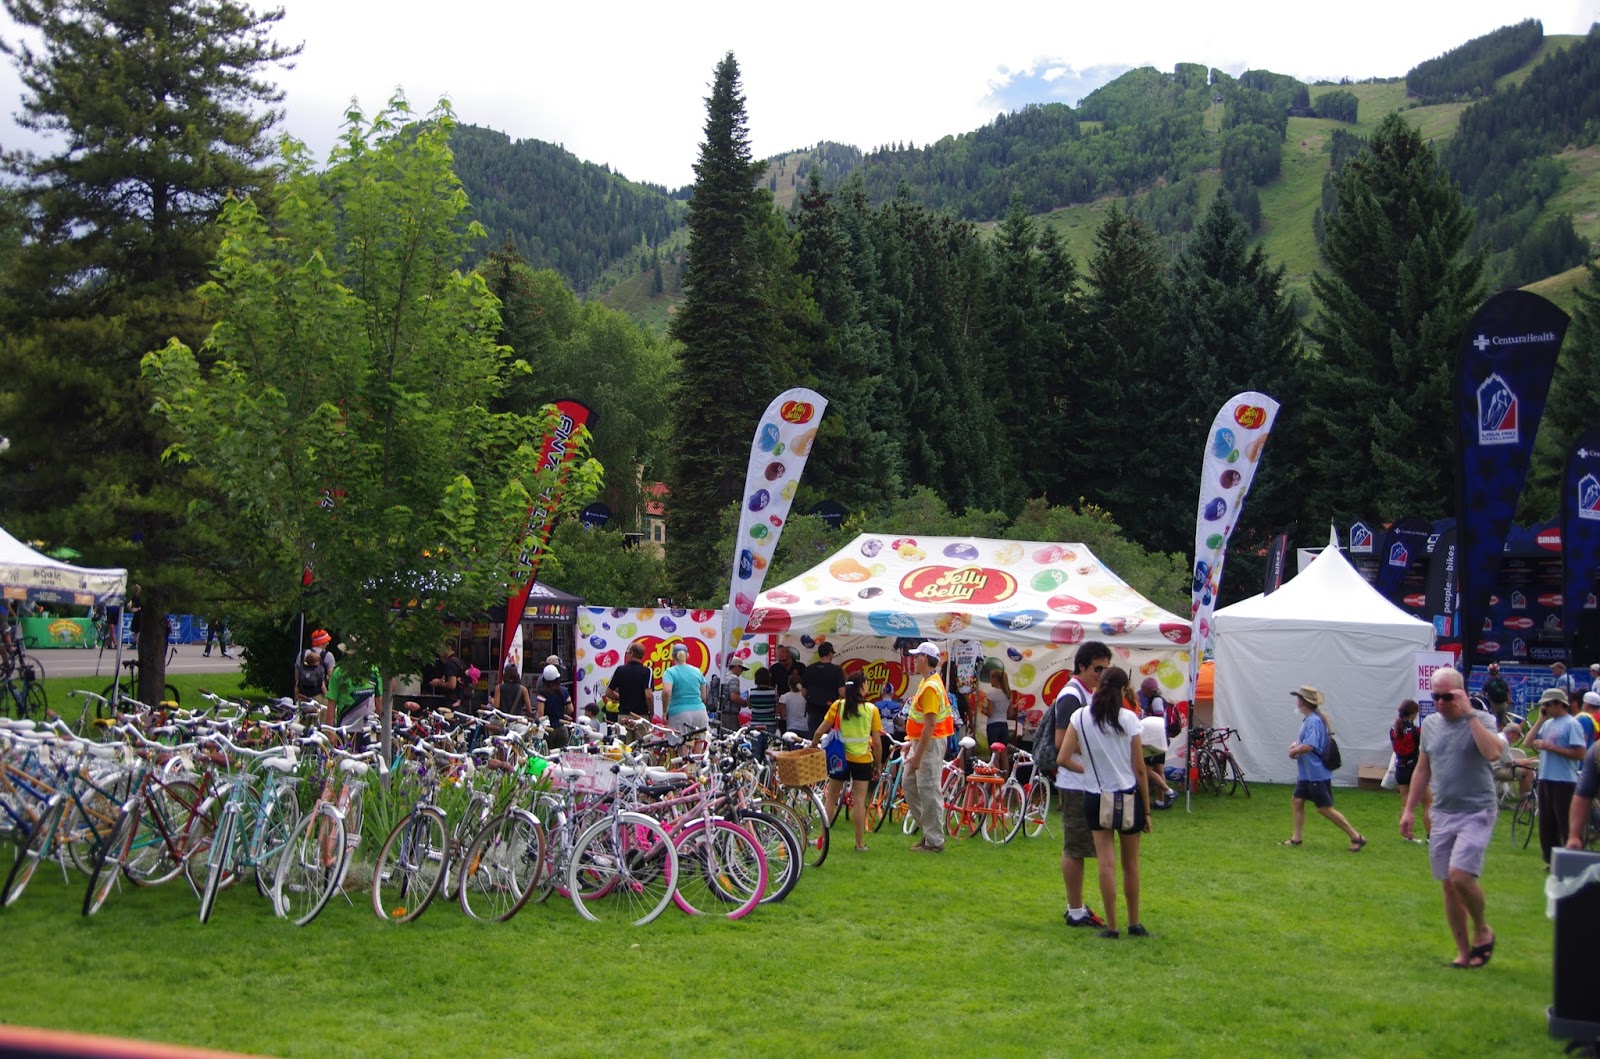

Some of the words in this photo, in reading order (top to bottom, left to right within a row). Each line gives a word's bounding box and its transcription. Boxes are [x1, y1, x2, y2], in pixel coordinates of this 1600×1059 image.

[1537, 535, 1562, 544] smas
[935, 564, 989, 589] Jelly
[914, 583, 975, 604] Belly
